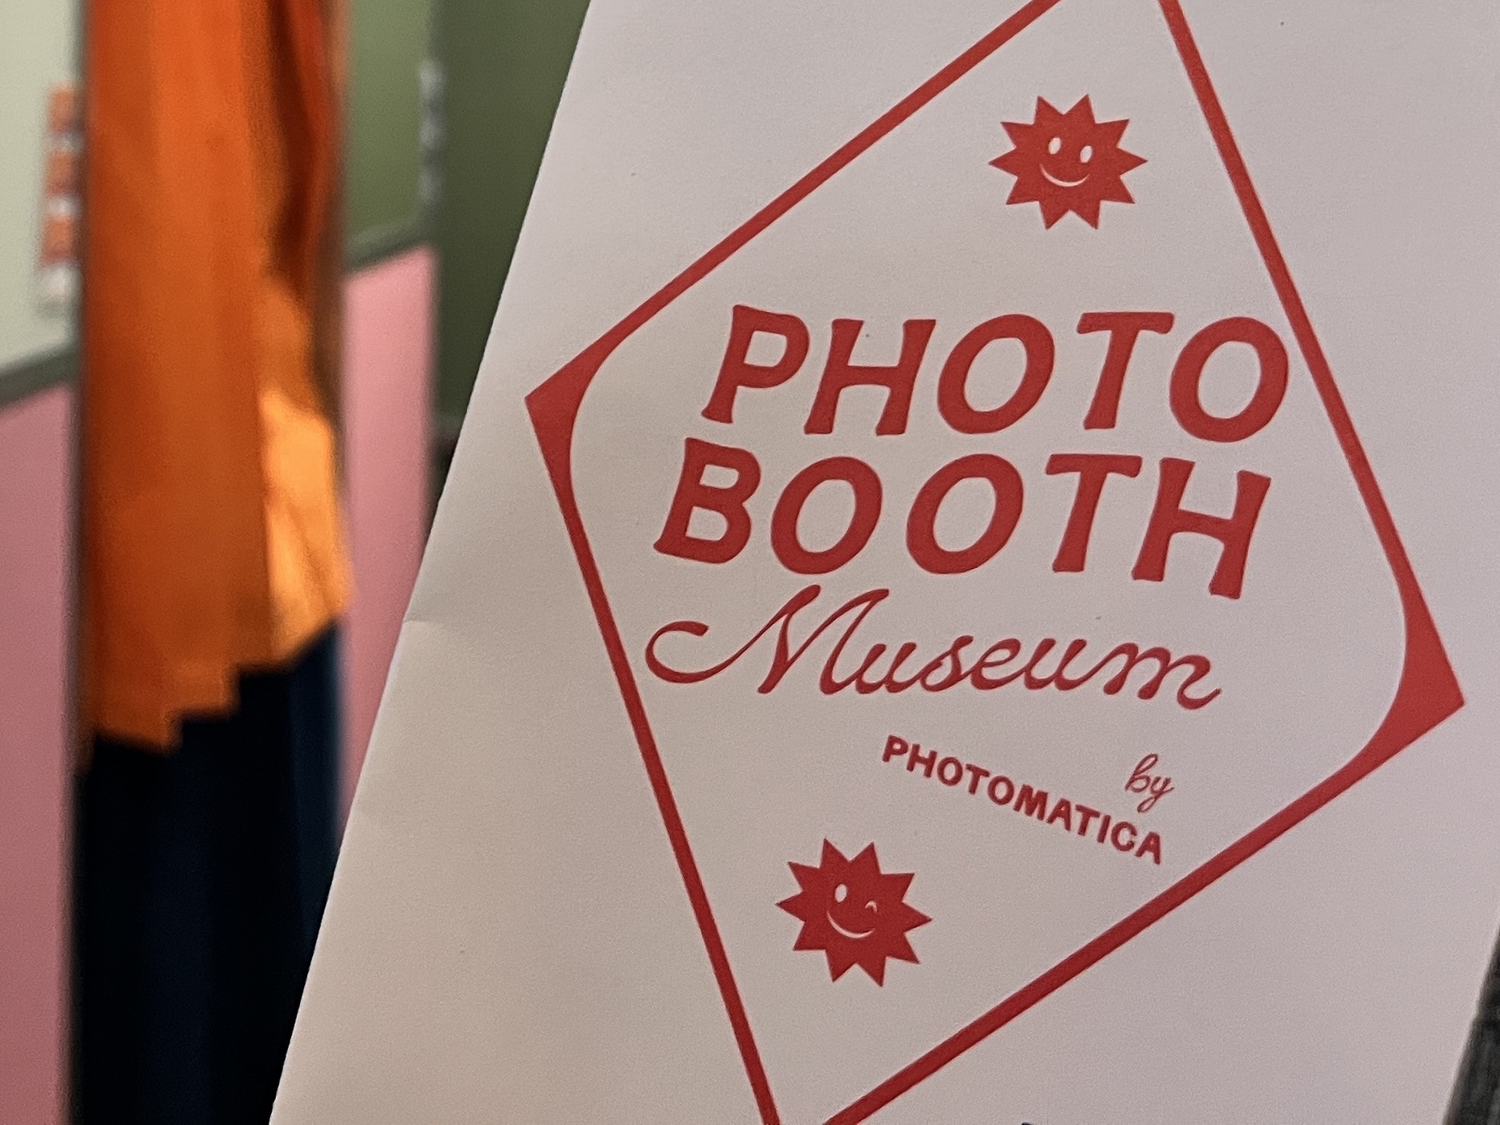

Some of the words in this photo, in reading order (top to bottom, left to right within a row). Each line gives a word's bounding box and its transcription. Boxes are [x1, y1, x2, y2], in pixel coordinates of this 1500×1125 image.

[702, 304, 1290, 443] PHOTO
[653, 437, 1272, 600] BOOTH
[645, 584, 1222, 711] Museum
[881, 735, 1164, 865] PHOTOMATICA
[1124, 752, 1174, 813] by
